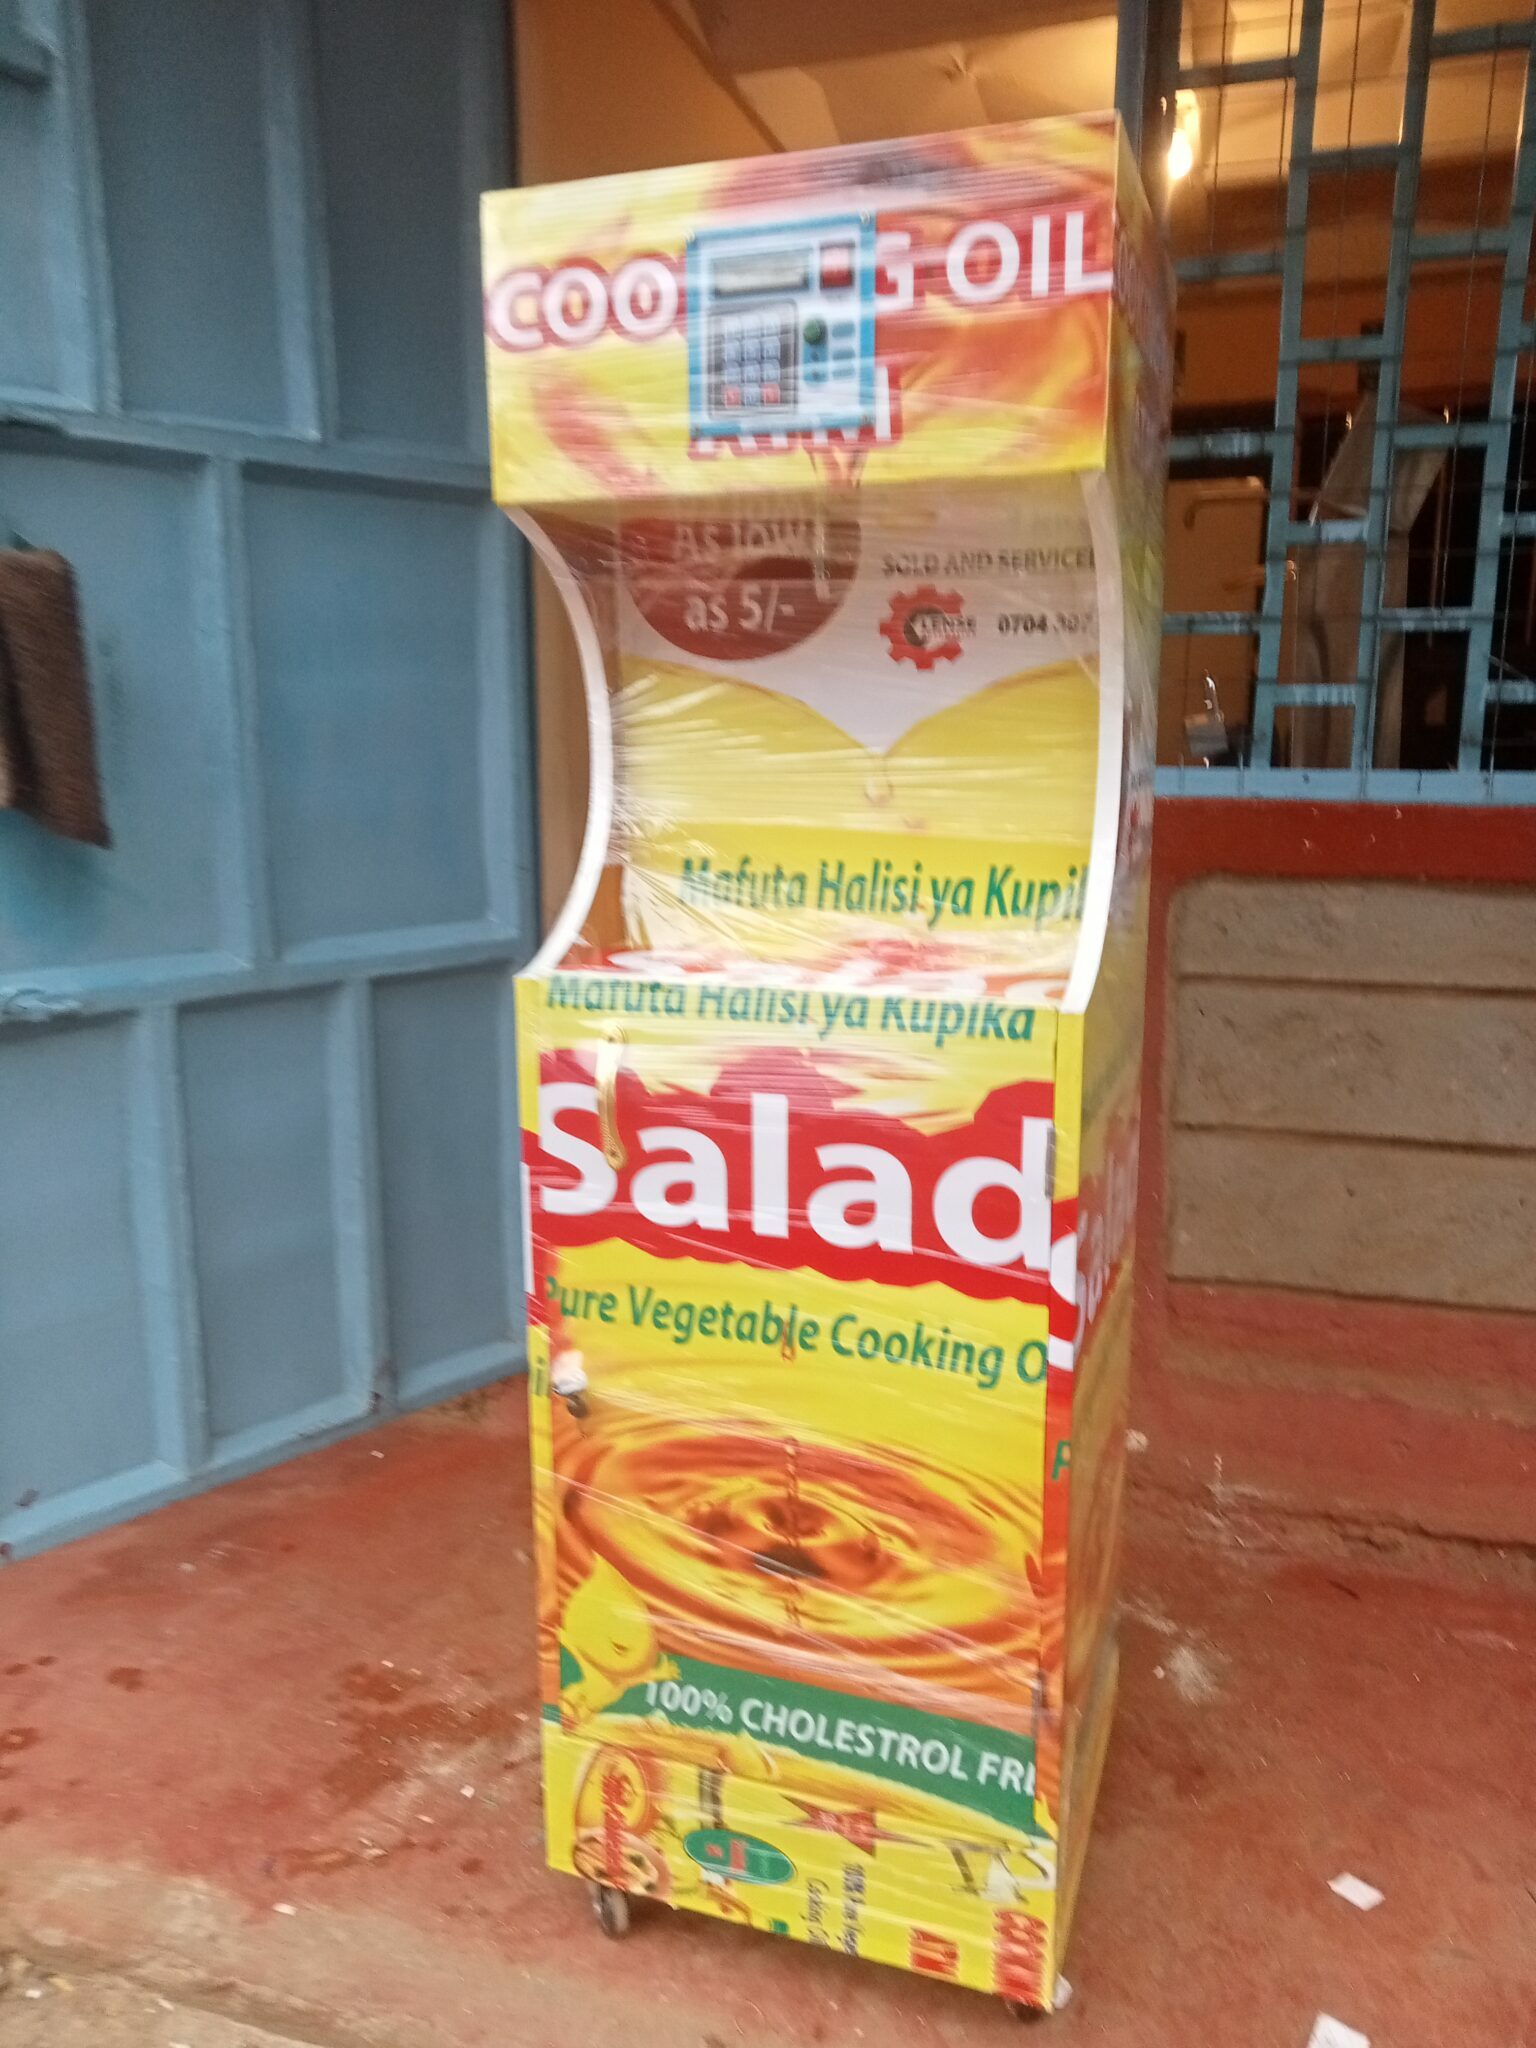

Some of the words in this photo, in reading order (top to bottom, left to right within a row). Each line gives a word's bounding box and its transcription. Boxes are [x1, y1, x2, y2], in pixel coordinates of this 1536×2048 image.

[945, 209, 1114, 303] OIL
[944, 550, 993, 577] AND
[685, 595, 729, 633] as
[679, 855, 807, 910] Mafuta
[818, 858, 923, 915] Halisi
[929, 876, 976, 930] ya
[822, 991, 870, 1041] ya
[881, 994, 1036, 1048] Kupika
[539, 1081, 1055, 1271] Salad
[627, 1282, 821, 1353] Vegetable
[830, 1313, 1004, 1389] Cooking
[644, 1680, 734, 1725] 100%
[740, 1697, 969, 1782] CHOLESTROL
